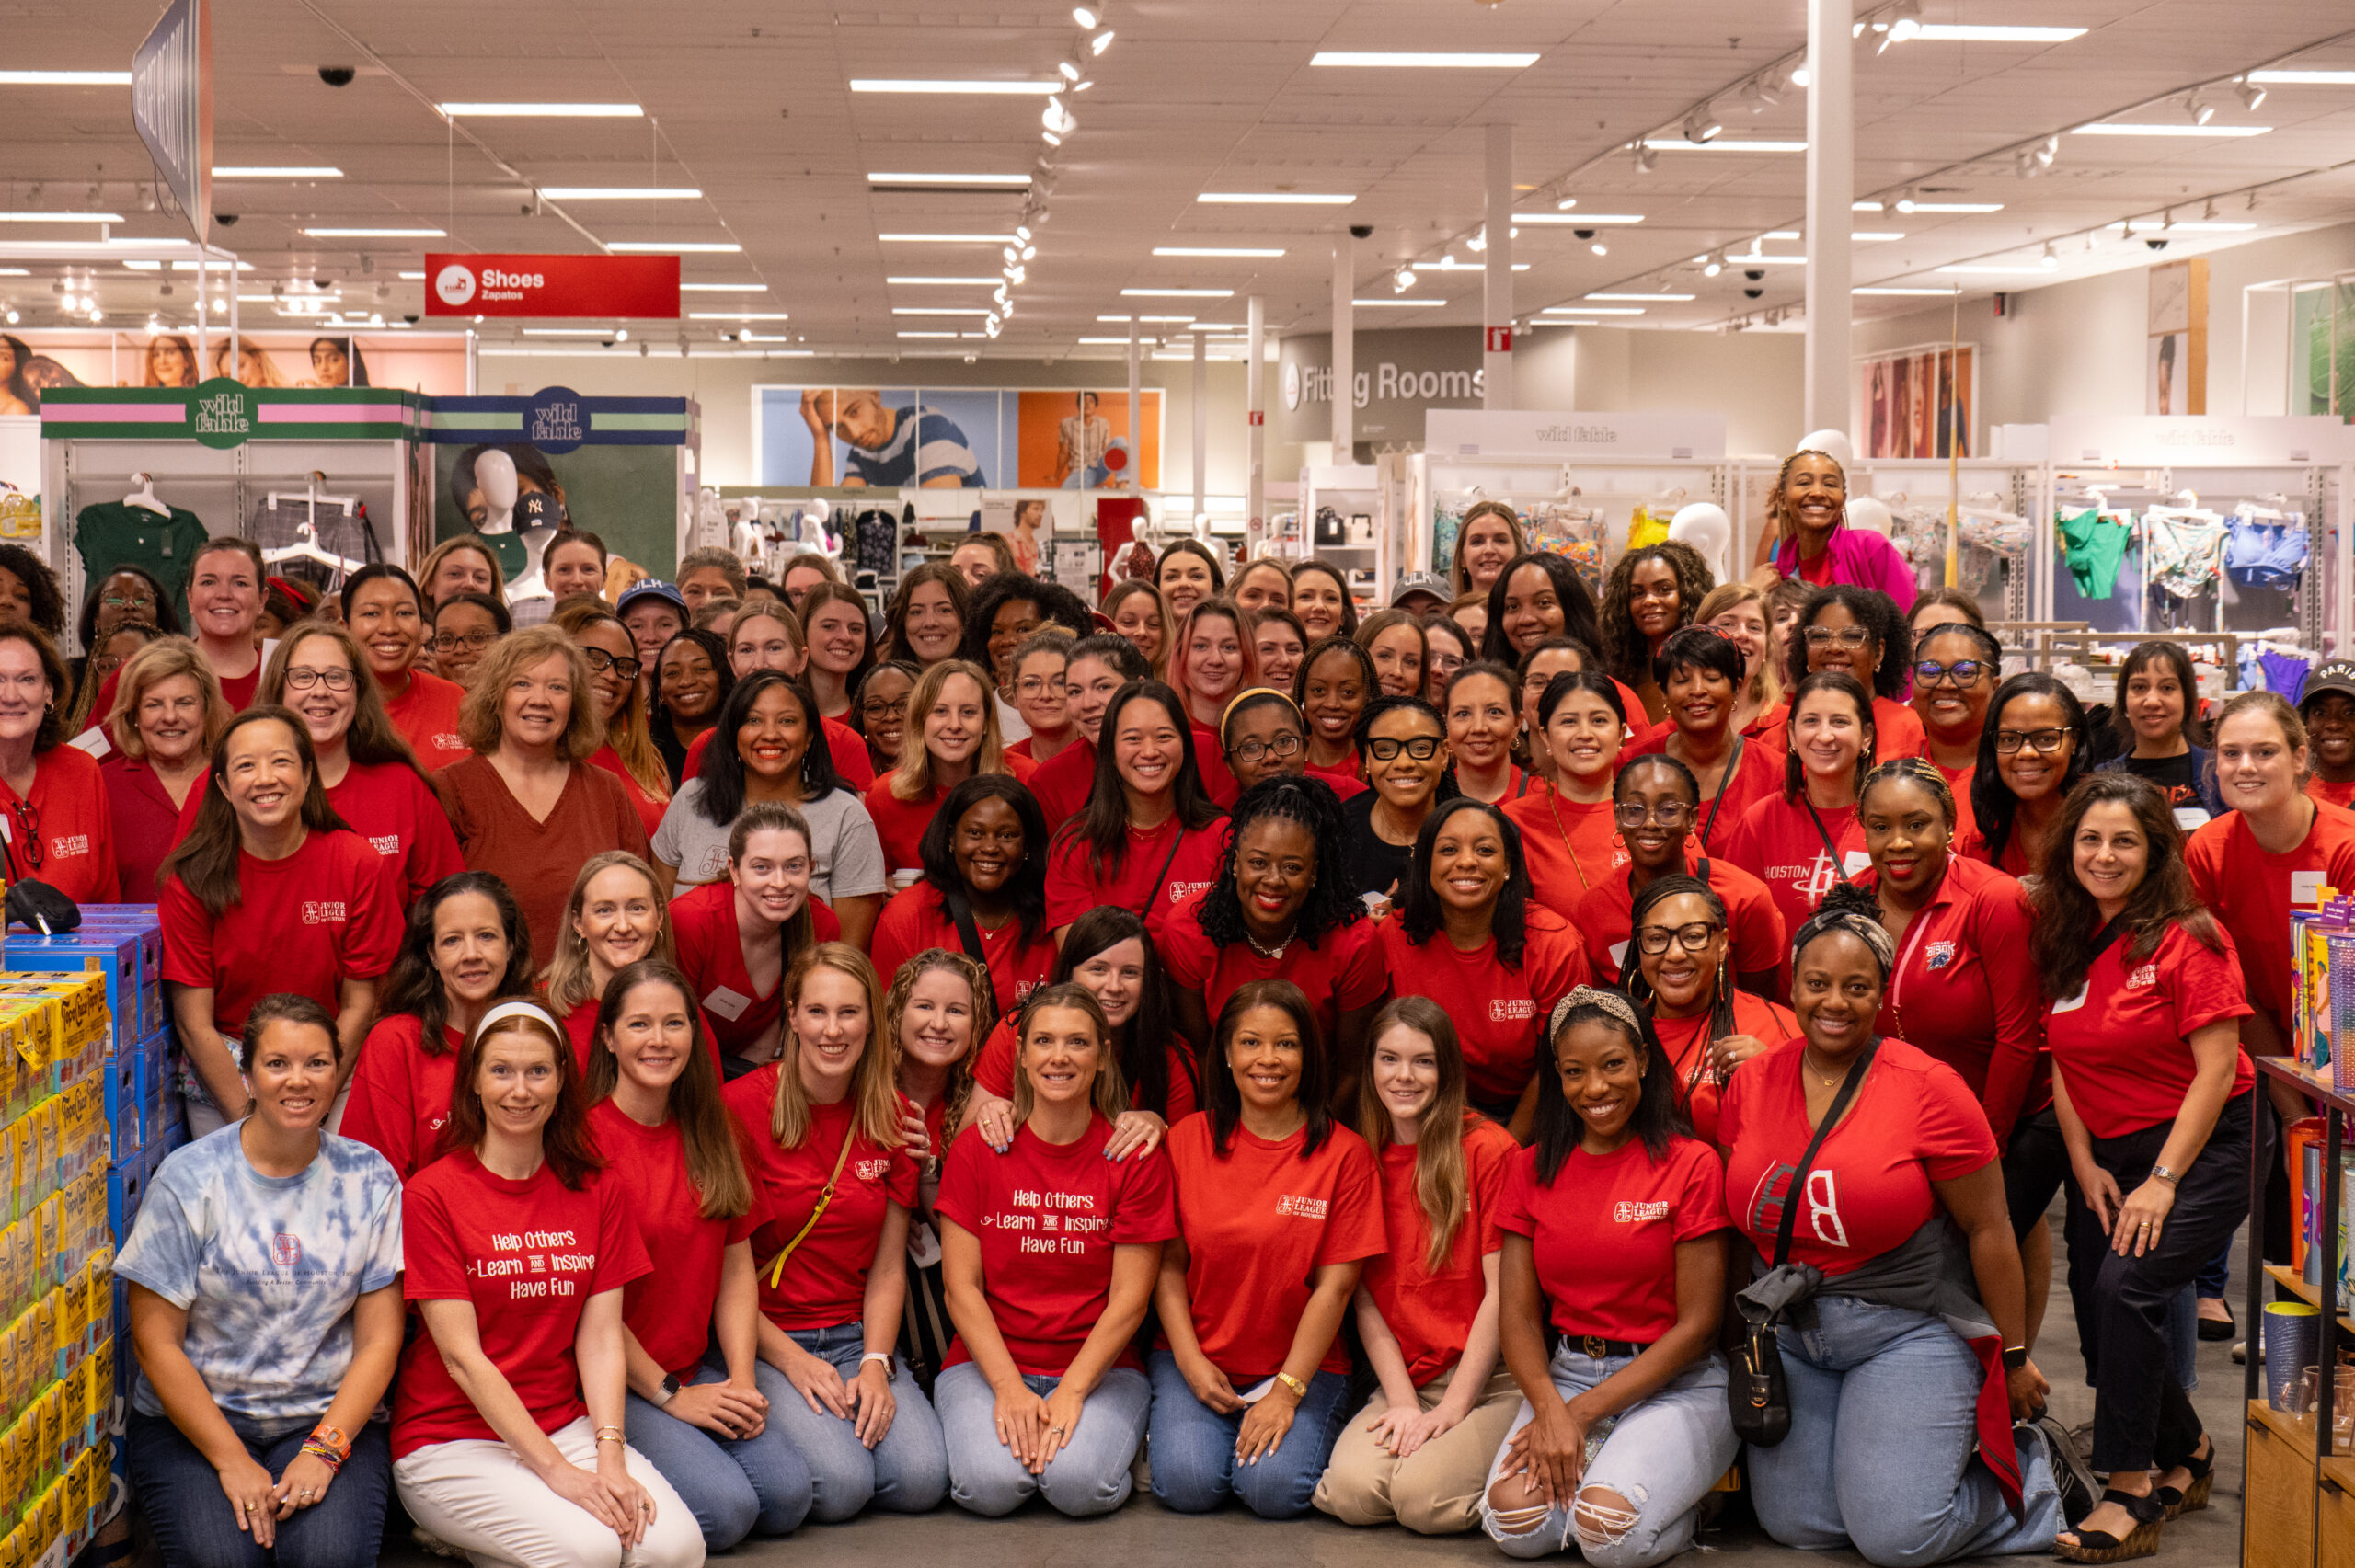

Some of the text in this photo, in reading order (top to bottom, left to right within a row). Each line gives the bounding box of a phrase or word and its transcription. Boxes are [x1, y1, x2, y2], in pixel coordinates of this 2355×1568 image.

[482, 269, 545, 289] Shoes
[482, 290, 523, 301] Zapatos
[1304, 362, 1485, 408] Fittg Rooms
[199, 394, 244, 415] wild
[535, 403, 578, 423] wild
[196, 411, 249, 433] fable
[532, 421, 582, 441] fable
[1536, 426, 1617, 442] wild fable
[2193, 429, 2235, 446] fable
[369, 834, 399, 844] JUNIOR
[374, 840, 399, 851] EAGUE
[1188, 881, 1213, 889] JUNIO
[321, 909, 347, 917] LEGUE
[1925, 942, 1957, 957] BISON
[2142, 971, 2156, 979] LEA
[1013, 1189, 1094, 1208] Help Others
[1296, 1196, 1327, 1207] JUNIOR
[1634, 1201, 1669, 1209] JUNIOR
[1294, 1204, 1327, 1215] LEAGUE
[1634, 1207, 1669, 1217] LEAGUE
[996, 1211, 1109, 1233] Learn AND Inspire
[492, 1230, 576, 1252] Help Others
[1021, 1236, 1085, 1254] Have Fun
[477, 1253, 595, 1277] Learn AND Inspire
[511, 1277, 575, 1299] Have Fun
